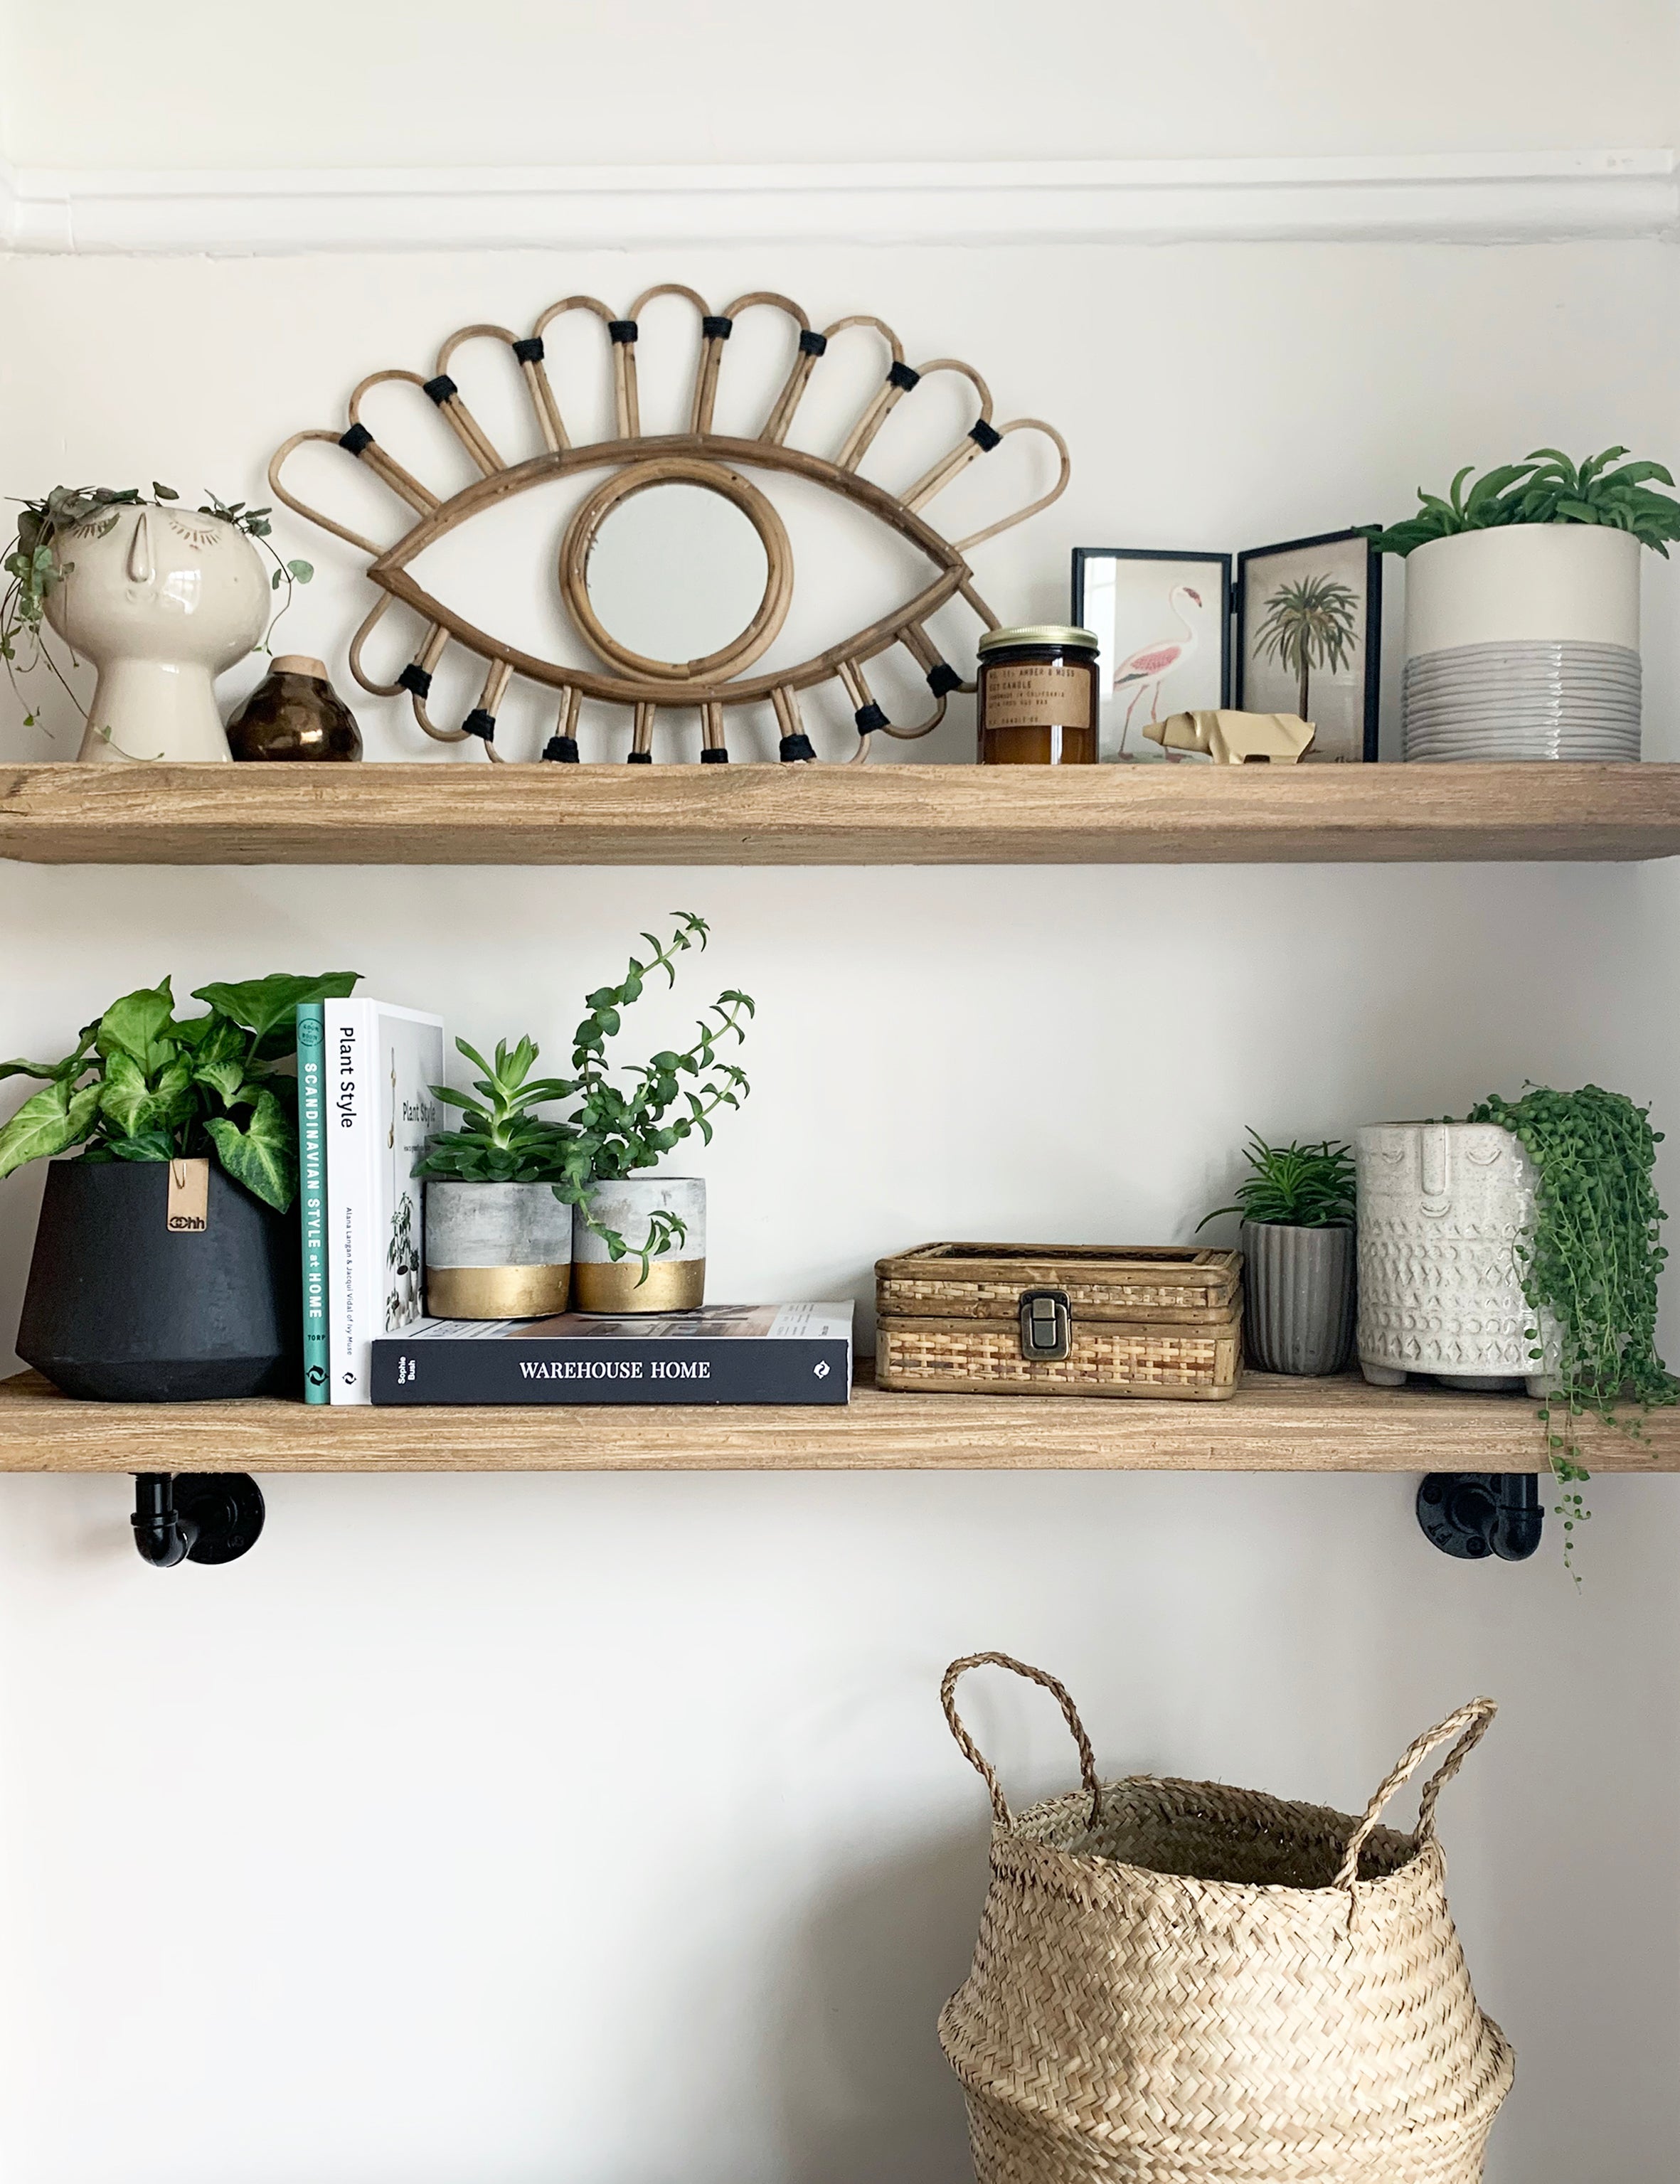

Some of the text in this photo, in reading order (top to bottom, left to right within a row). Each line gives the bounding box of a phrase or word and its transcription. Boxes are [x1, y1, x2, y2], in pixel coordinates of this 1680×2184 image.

[1056, 668, 1075, 677] MOSS
[336, 1027, 357, 1128] Plant Style
[403, 1100, 435, 1128] Plant Style
[304, 1062, 322, 1318] SCANDINAVIAN STYLE at HOME
[345, 1267, 353, 1291] Jacqui
[346, 1314, 353, 1323] of
[398, 1355, 406, 1385] Sophie
[519, 1361, 711, 1379] WAREHOUSE HOME
